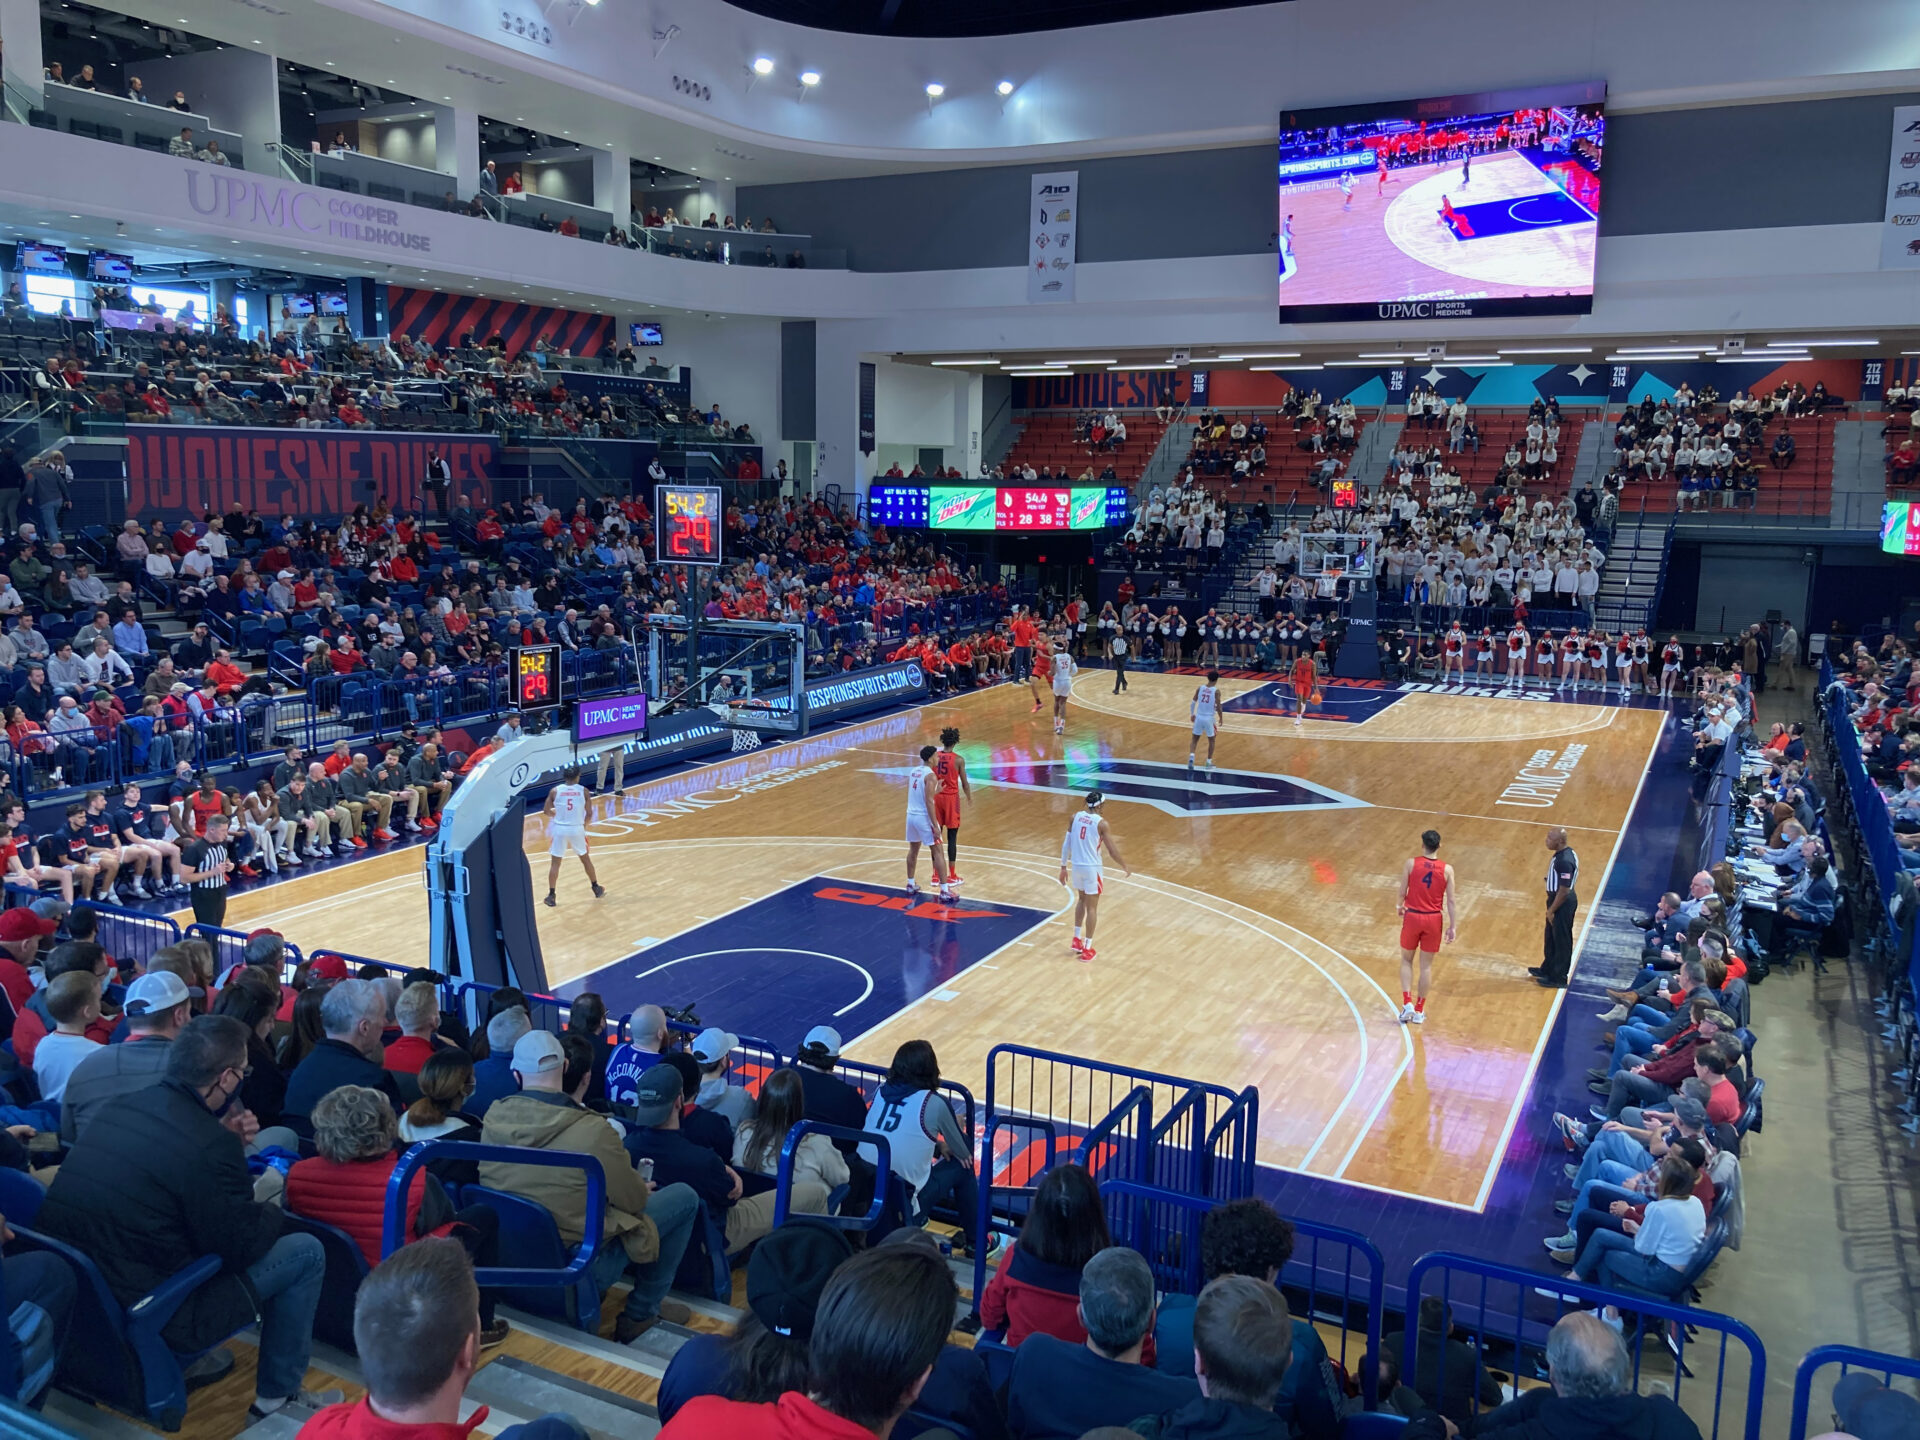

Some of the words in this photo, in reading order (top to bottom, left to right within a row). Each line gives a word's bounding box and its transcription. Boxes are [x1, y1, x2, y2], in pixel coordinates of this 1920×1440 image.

[184, 168, 321, 233] UPMC
[328, 198, 399, 226] COOPER
[1897, 215, 1919, 225] VCU
[328, 219, 431, 252] FIELDHOUSE
[1378, 303, 1430, 319] UPMC
[1435, 302, 1466, 310] SPORTS
[1435, 309, 1473, 317] MEDICINE
[1613, 366, 1627, 377] 213
[1866, 363, 1881, 374] 212
[1193, 374, 1205, 384] 215
[1391, 371, 1404, 381] 214
[1612, 376, 1626, 387] 214
[1865, 374, 1880, 385] 213
[1193, 383, 1205, 393] 216
[1390, 380, 1403, 391] 215
[1025, 493, 1048, 503] 54.4
[1335, 490, 1356, 507] 29
[1020, 514, 1032, 524] 28
[1040, 514, 1052, 525] 38
[672, 516, 711, 554] 29
[1350, 618, 1373, 626] UPMC
[520, 655, 545, 675] 54.2
[524, 675, 548, 700] 29
[1396, 682, 1554, 702] DUKES
[1201, 694, 1210, 704] 23
[621, 704, 641, 713] HEALTH
[584, 707, 619, 727] UPMC
[621, 712, 636, 720] PLAN
[938, 761, 949, 775] 15
[717, 767, 795, 790] COOPER
[741, 760, 848, 794] FIELDHOUSE
[912, 779, 917, 791] 4
[1495, 768, 1571, 808] UPMC
[567, 798, 573, 811] 5
[585, 787, 742, 837] UPMC
[1422, 871, 1433, 889] 4
[875, 1101, 908, 1133] 15
